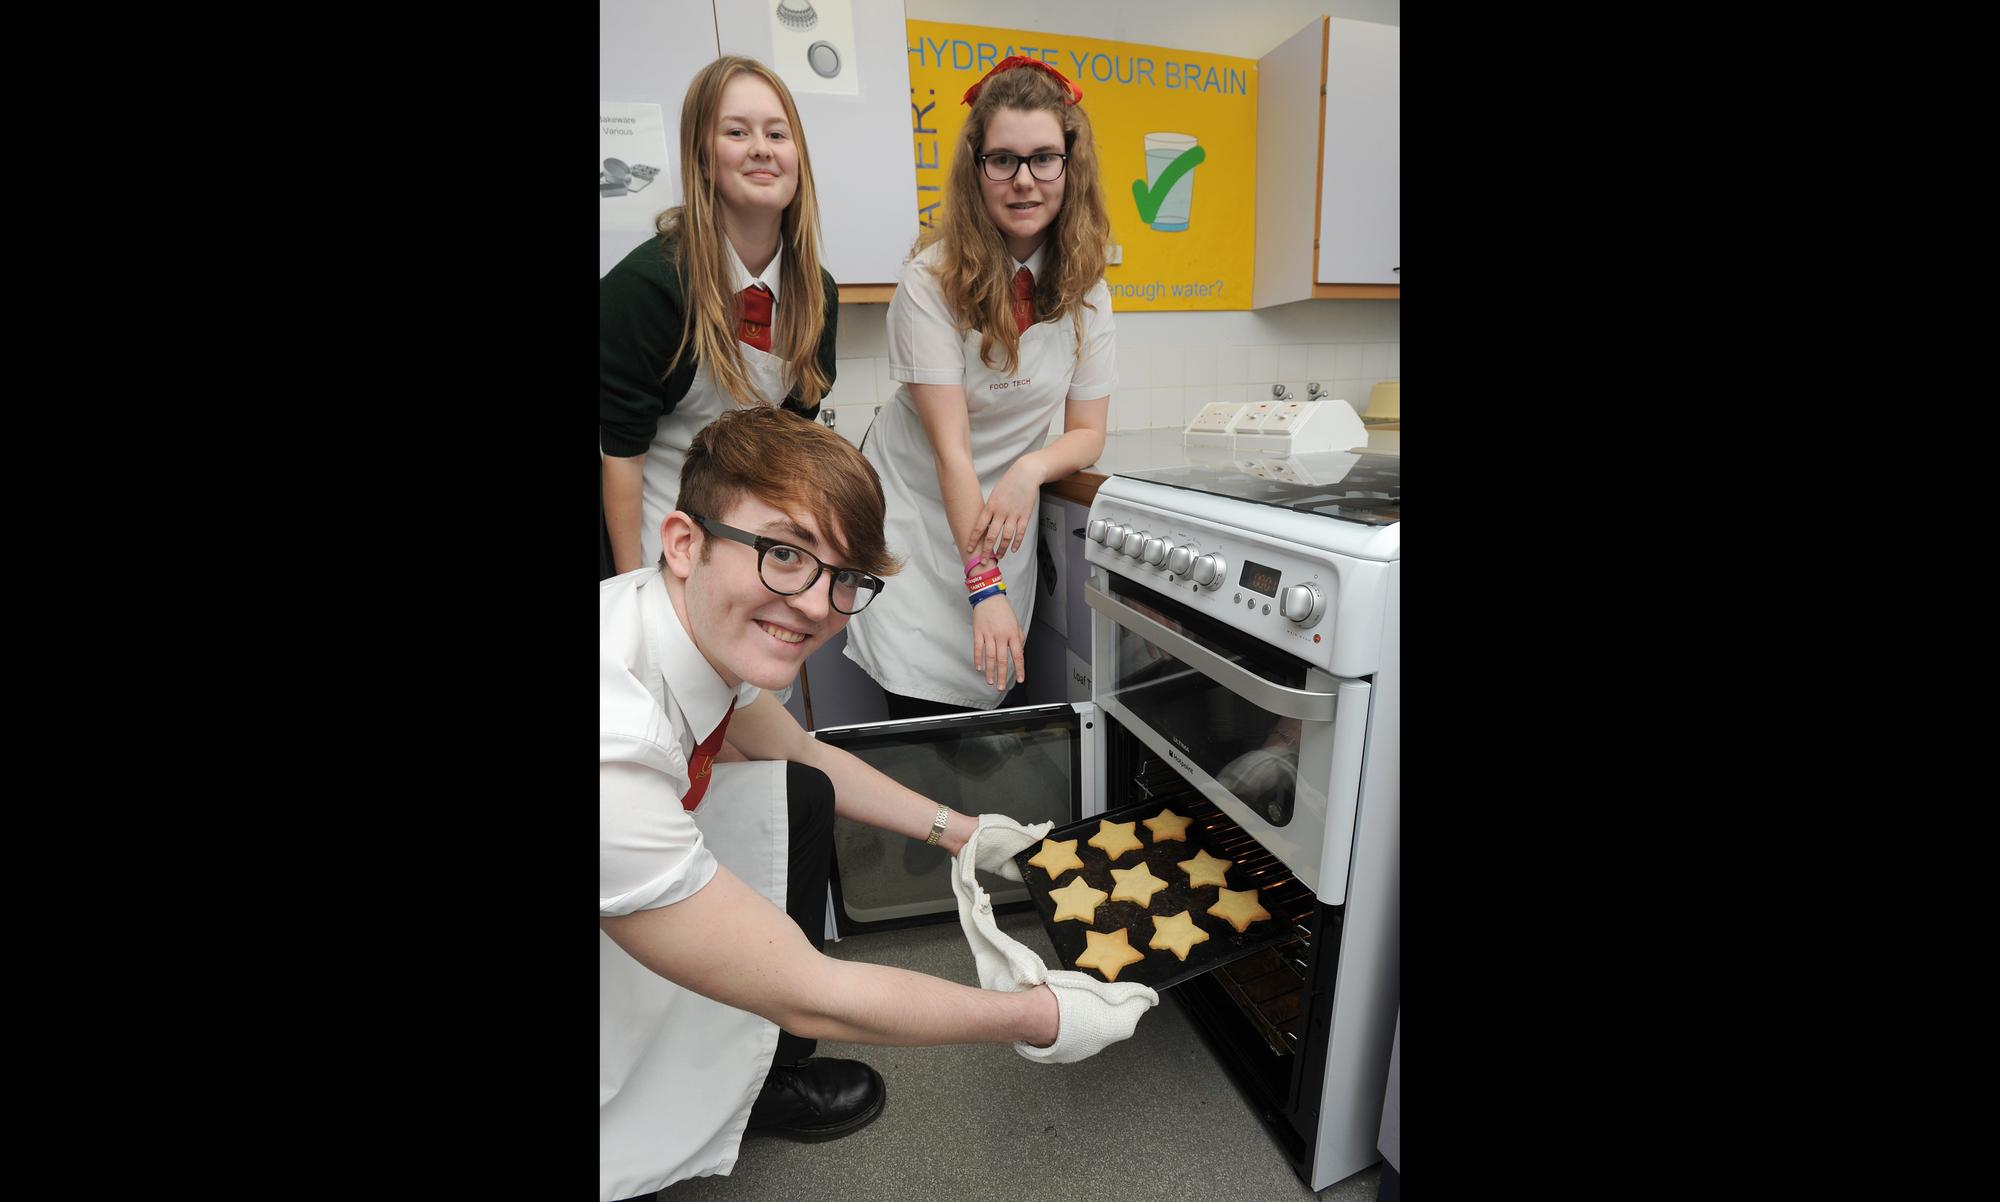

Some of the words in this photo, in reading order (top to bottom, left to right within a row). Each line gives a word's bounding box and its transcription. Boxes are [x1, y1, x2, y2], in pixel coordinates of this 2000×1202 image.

[1069, 51, 1155, 87] YOUR
[1165, 61, 1246, 95] BRAIN
[1170, 280, 1224, 297] water?
[989, 382, 1008, 390] FOOD
[1012, 378, 1031, 387] TECH
